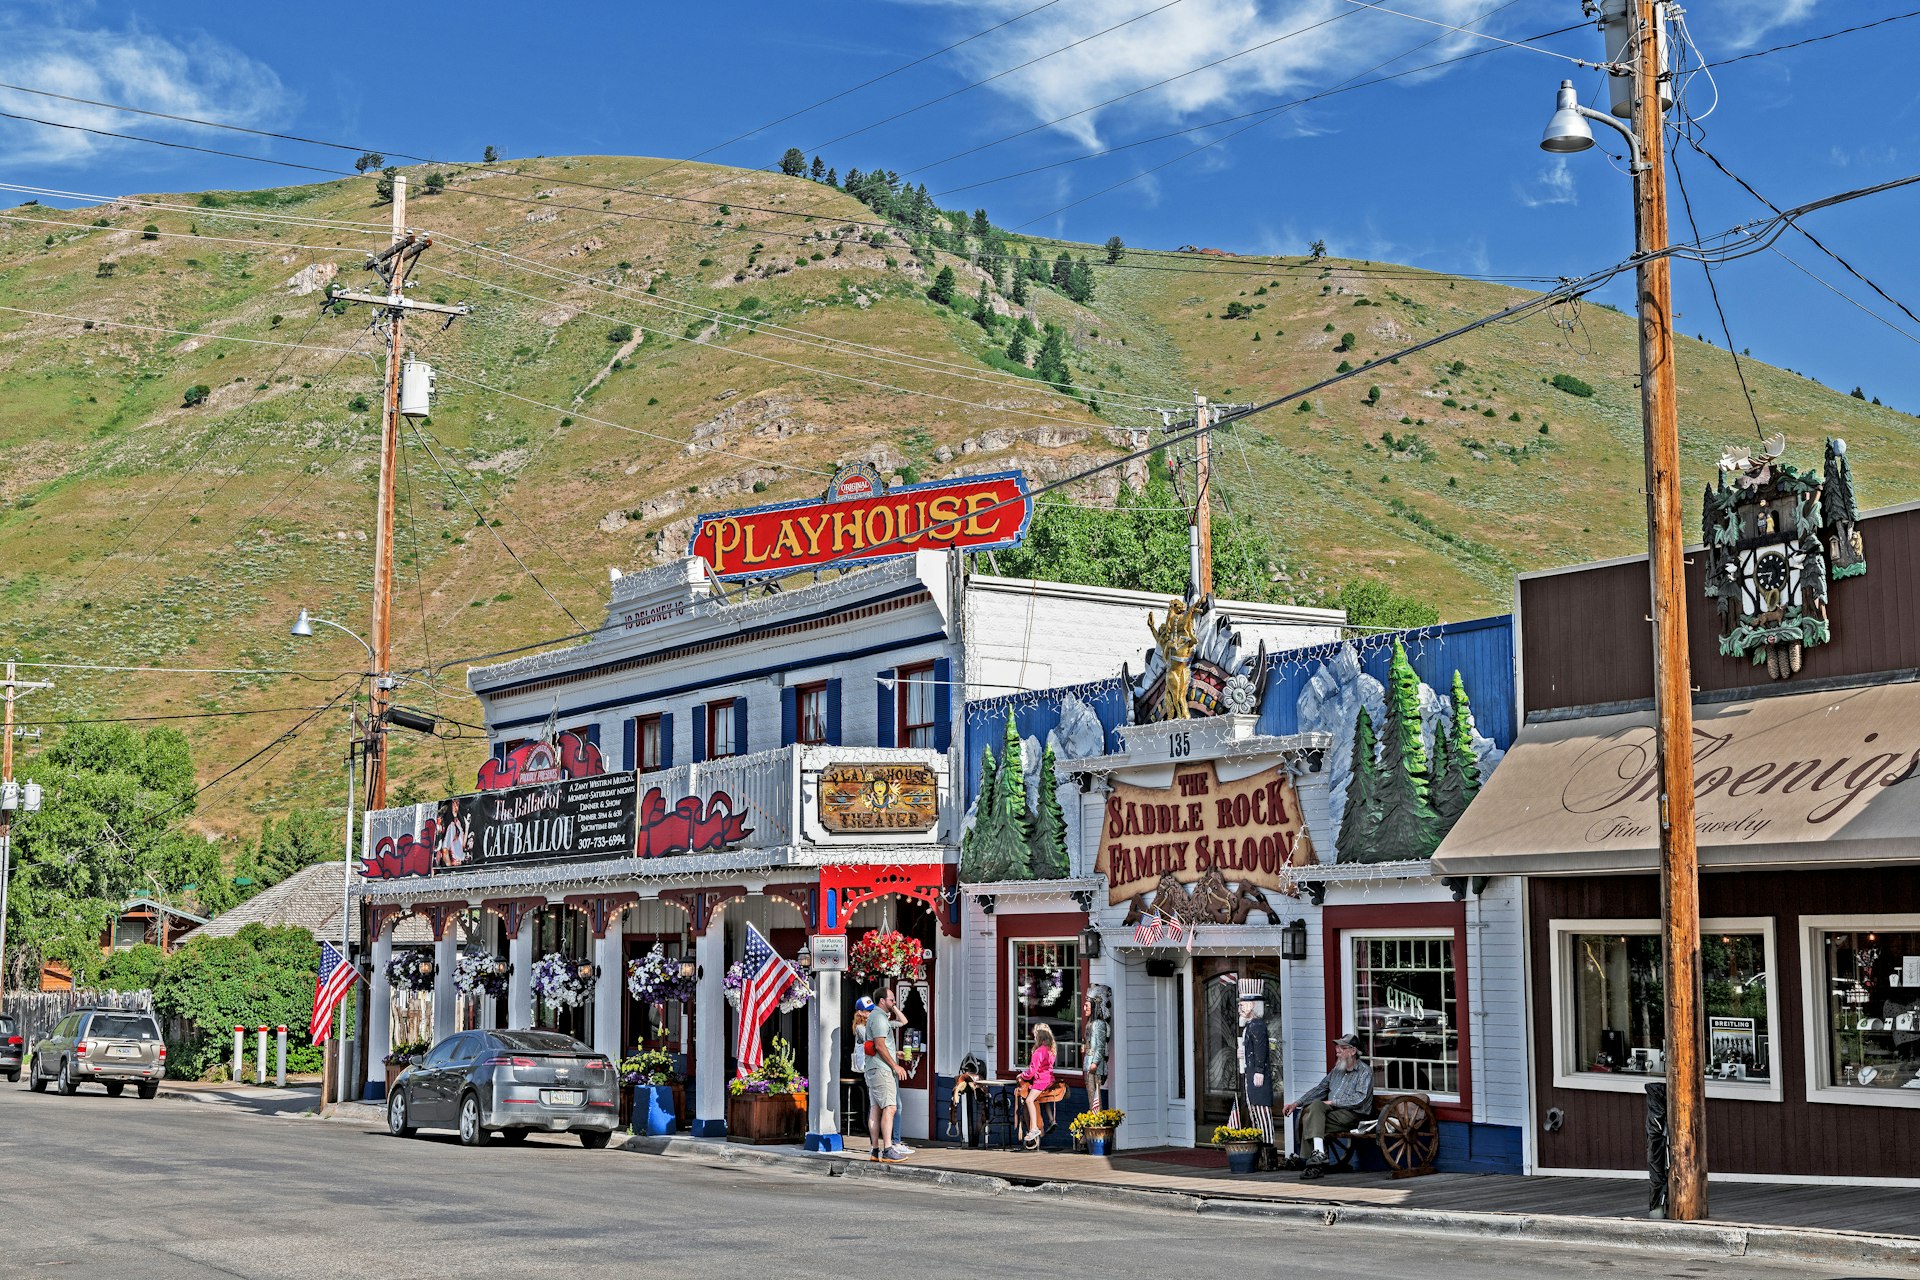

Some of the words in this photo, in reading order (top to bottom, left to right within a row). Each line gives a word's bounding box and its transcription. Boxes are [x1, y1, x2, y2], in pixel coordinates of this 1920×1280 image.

[833, 465, 860, 490] JACKSON
[860, 466, 878, 485] HOLE
[841, 481, 869, 493] ORIGINAL
[705, 491, 1001, 573] PLAYHOUSE
[635, 603, 672, 627] DELONEY
[1169, 732, 1191, 757] 135
[520, 772, 538, 784] PROUDLY
[538, 769, 558, 782] PRESENTS
[569, 784, 574, 792] A
[829, 768, 868, 786] PLAY
[886, 768, 928, 784] HOUSE
[1177, 772, 1209, 796] THE
[494, 799, 512, 820] The
[514, 790, 548, 818] Ballad
[548, 789, 562, 809] of
[1107, 795, 1204, 839] SADDLE
[1215, 777, 1290, 829] ROCK
[839, 812, 919, 828] THEATER
[1584, 815, 1652, 843] Fine
[1695, 808, 1772, 840] ewelry
[578, 834, 626, 850] 307-733-6994
[1107, 841, 1190, 889] FAMILY
[1194, 831, 1295, 876] SALOON
[1386, 986, 1425, 1021] GIFTS
[1714, 1020, 1750, 1028] BREITLING
